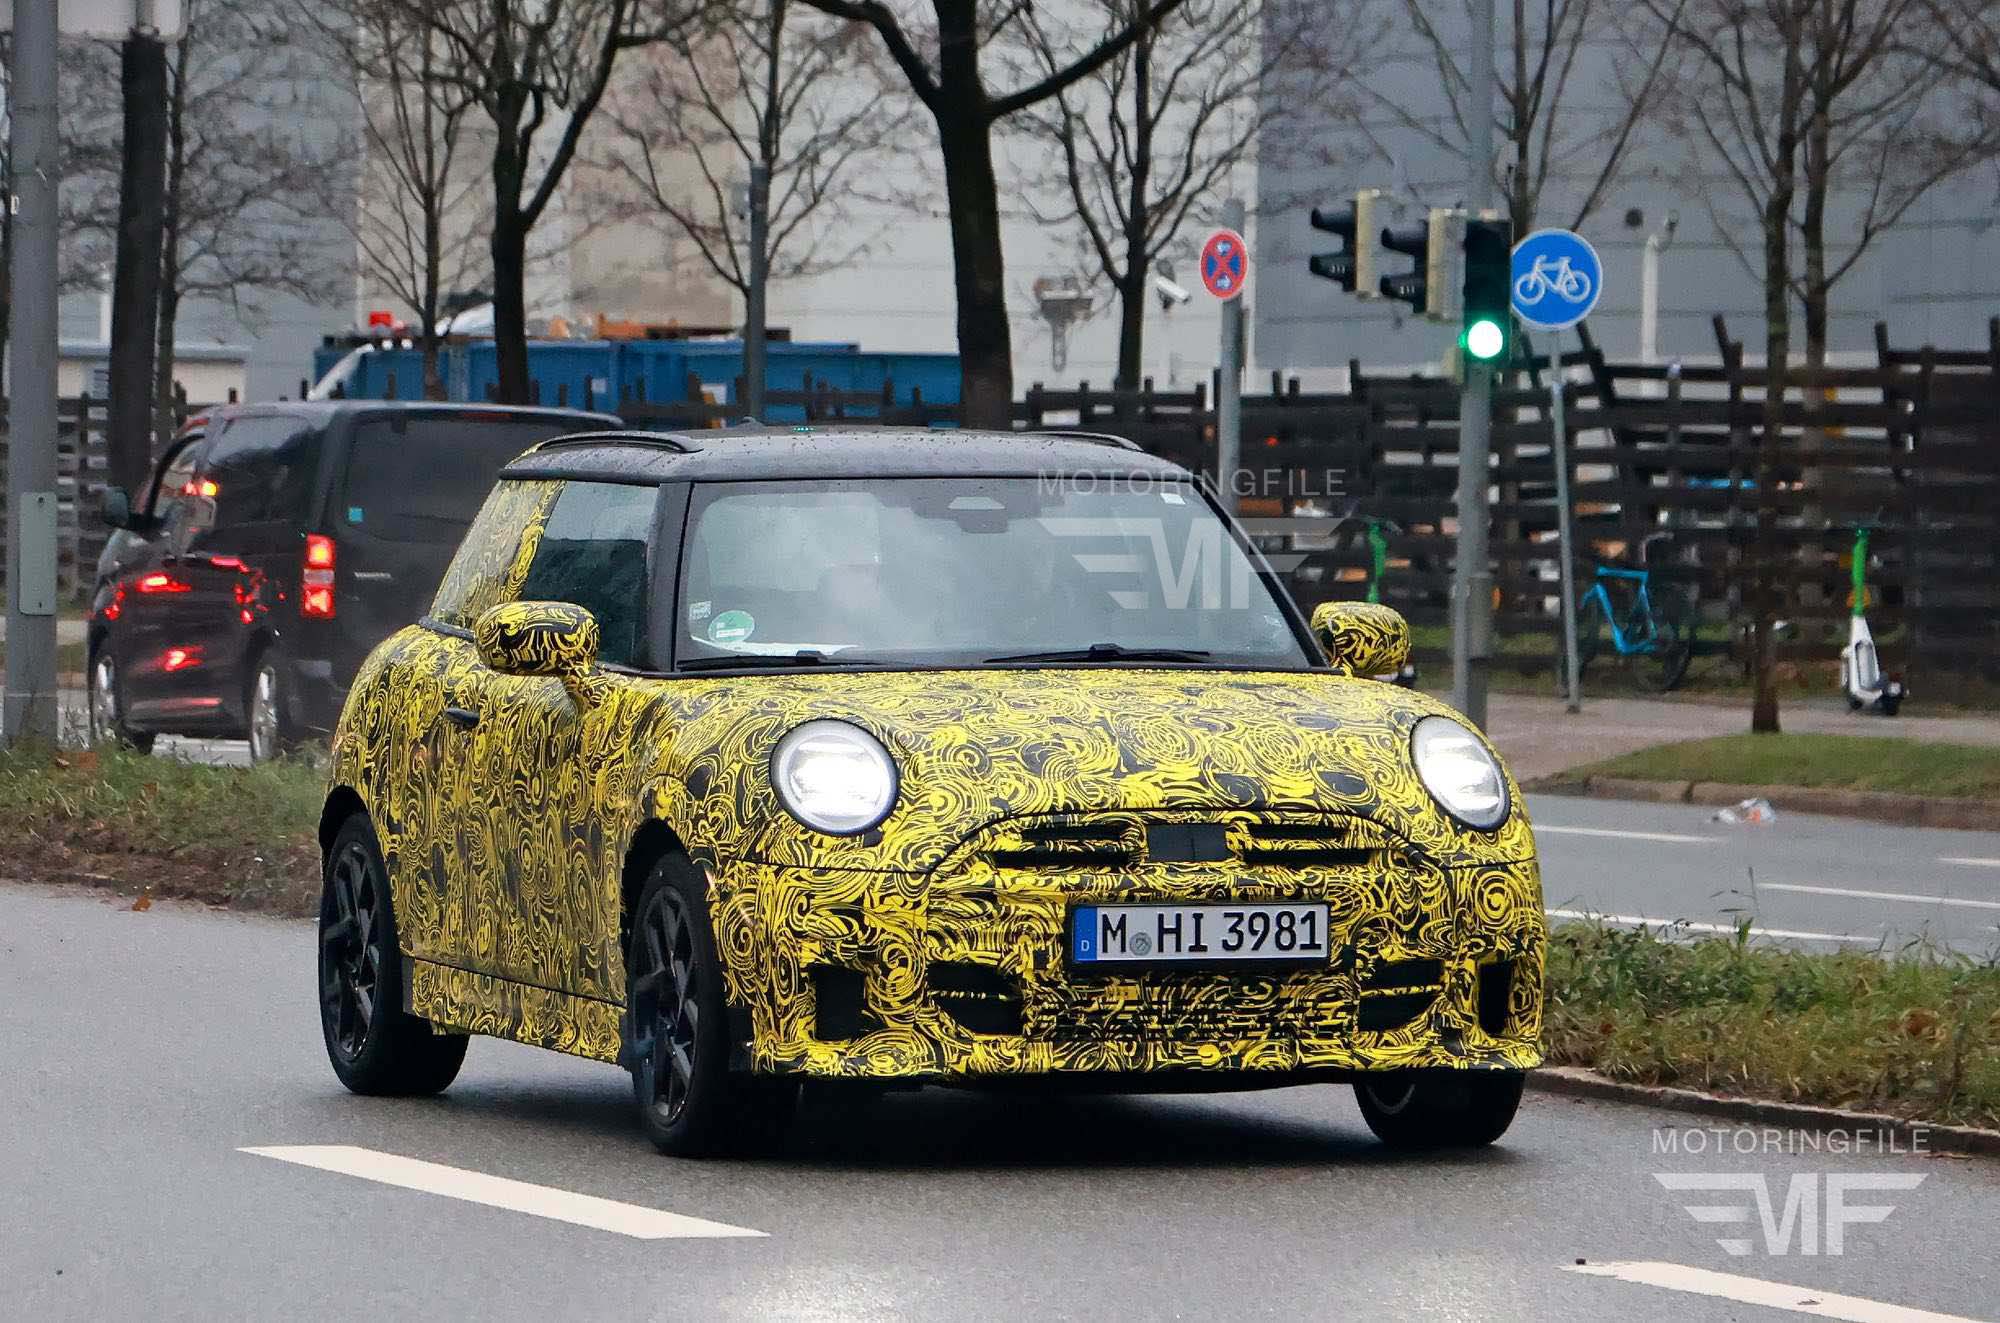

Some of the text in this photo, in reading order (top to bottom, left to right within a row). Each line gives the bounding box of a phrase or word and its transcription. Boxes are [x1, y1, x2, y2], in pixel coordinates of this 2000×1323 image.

[1080, 911, 1322, 954] D M HI 3981
